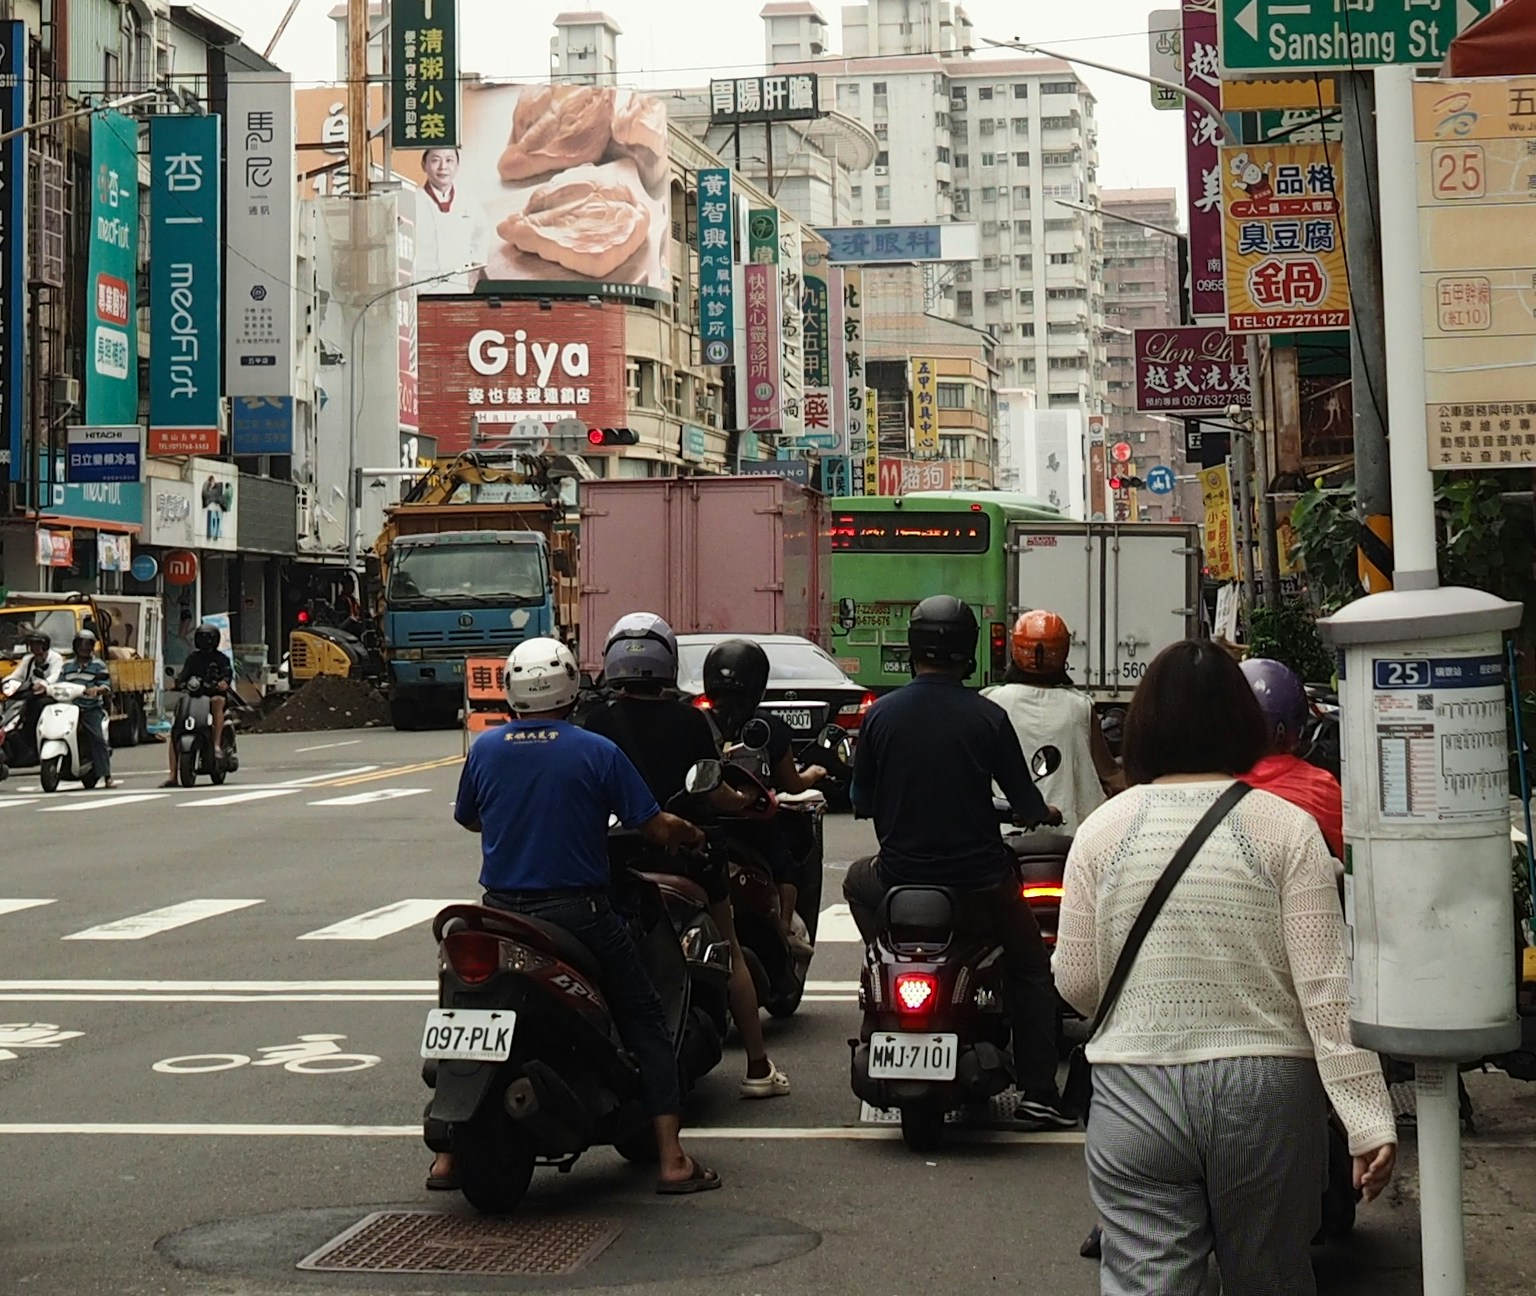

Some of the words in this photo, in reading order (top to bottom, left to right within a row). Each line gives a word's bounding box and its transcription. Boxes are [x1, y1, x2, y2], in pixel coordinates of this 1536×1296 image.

[1268, 21, 1395, 62] Sanshang
[1409, 19, 1446, 57] St.
[419, 28, 445, 139] 清粥小菜
[165, 152, 203, 224] 杏一
[1276, 163, 1335, 196] 品格
[1438, 153, 1481, 192] 25
[701, 175, 729, 250] 黃智興
[1239, 219, 1335, 255] 臭豆腐
[1250, 258, 1325, 306] 鍋
[169, 263, 199, 400] medFirst
[707, 301, 727, 338] 診所
[749, 272, 768, 379] 快樂心靈診所
[1234, 312, 1345, 329] TEL:07-7271127
[1443, 309, 1488, 326] (紅10)
[468, 329, 590, 388] Giya
[843, 283, 863, 412] 北京藥局
[468, 387, 591, 405] 姿也髮型連鎖店
[804, 393, 829, 430] 藥
[917, 361, 934, 448] 五甲釣具中心
[85, 431, 123, 439] HITACHI
[1388, 663, 1419, 685] 25
